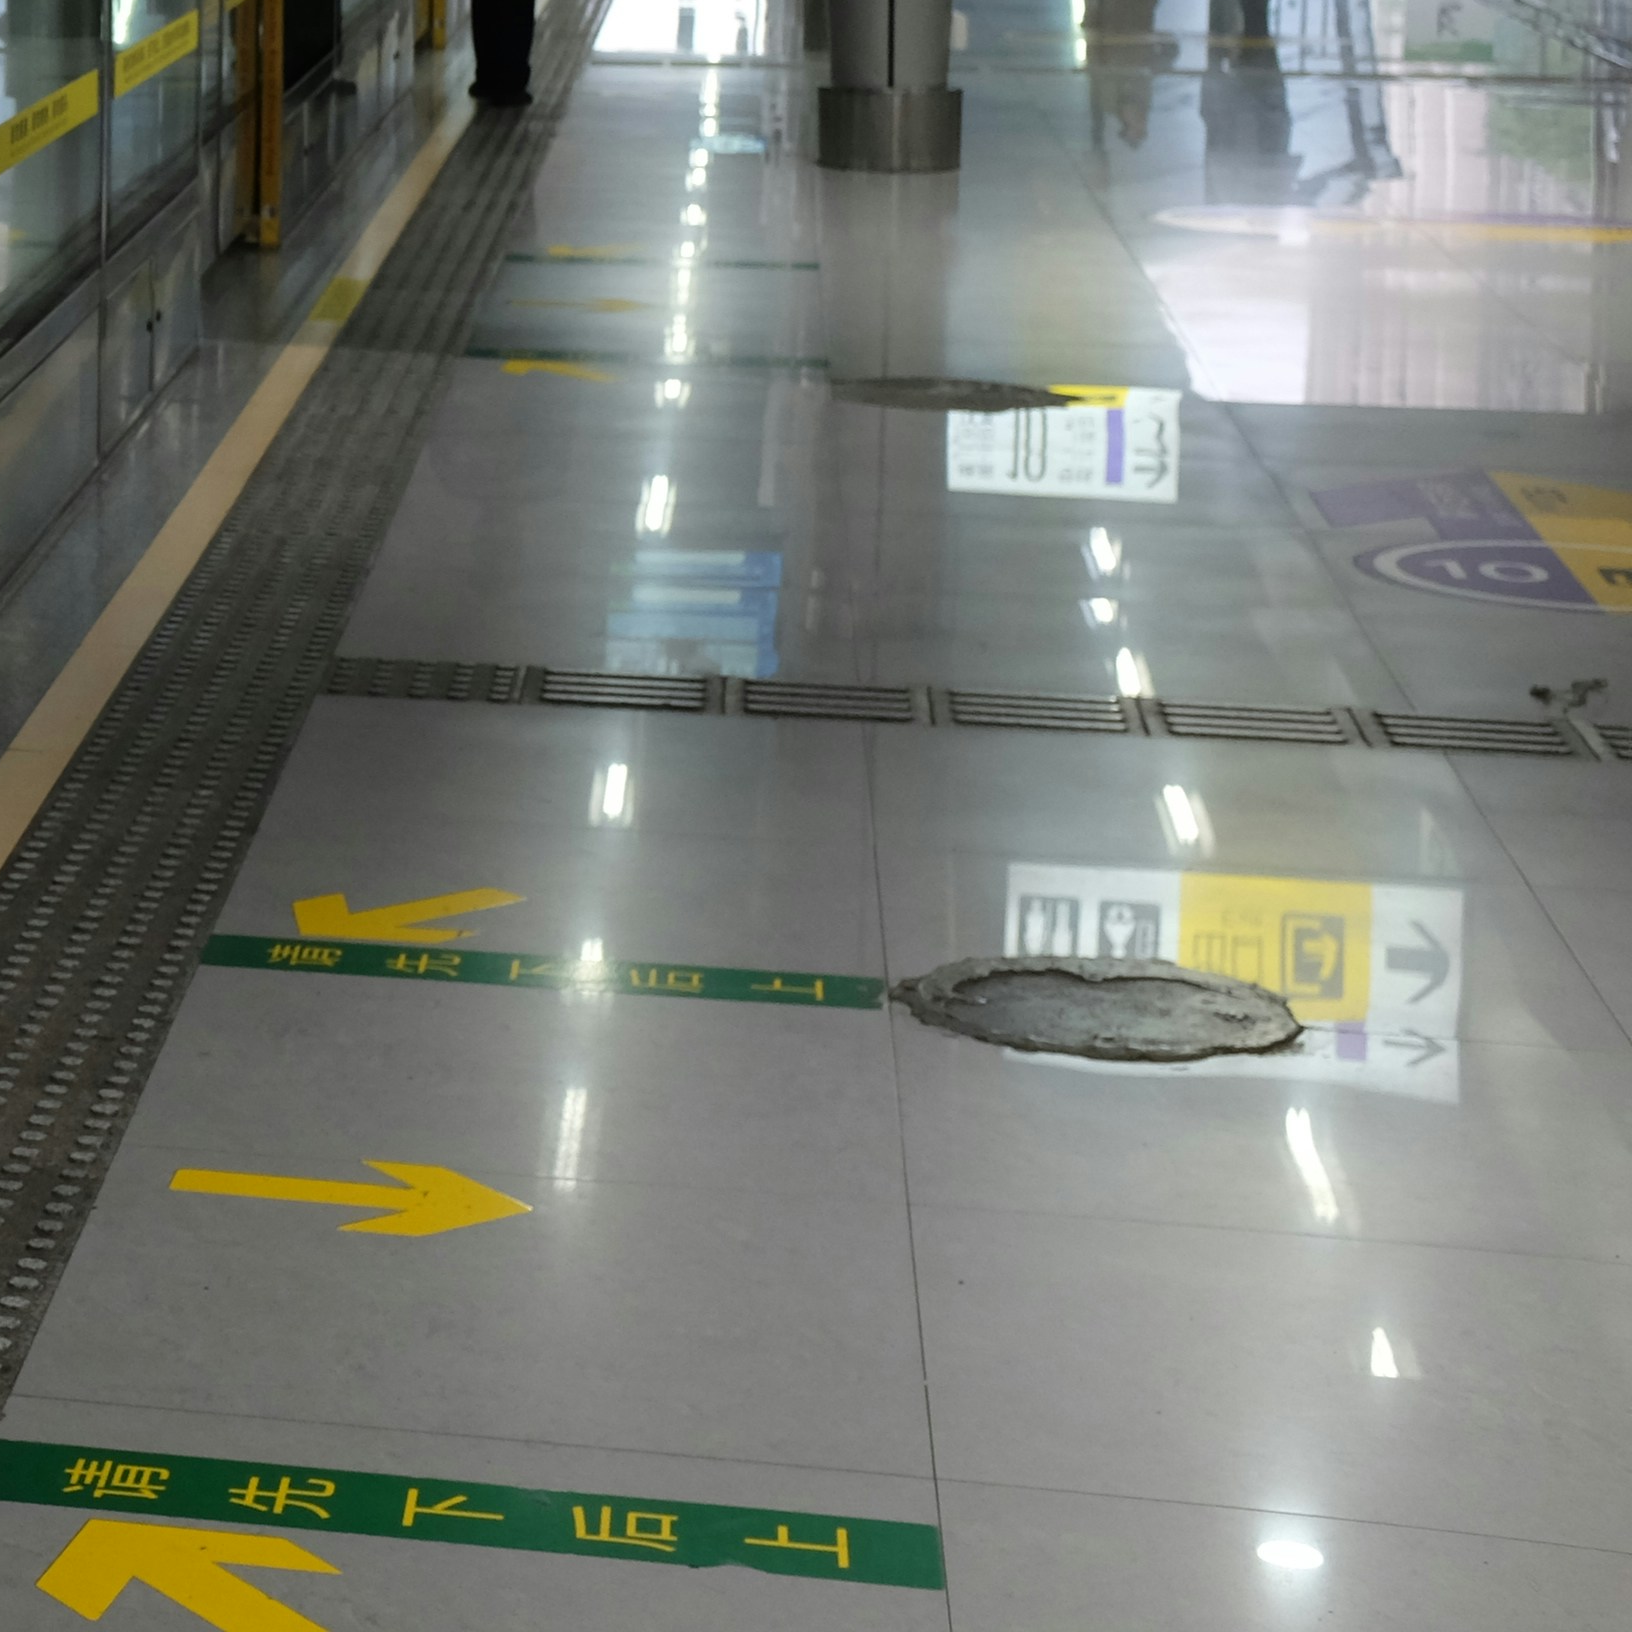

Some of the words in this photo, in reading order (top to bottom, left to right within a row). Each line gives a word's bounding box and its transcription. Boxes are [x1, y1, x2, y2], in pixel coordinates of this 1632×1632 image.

[1423, 557, 1549, 585] 10
[266, 942, 824, 1002] 请先下后上
[62, 1456, 851, 1570] 请先下后上
